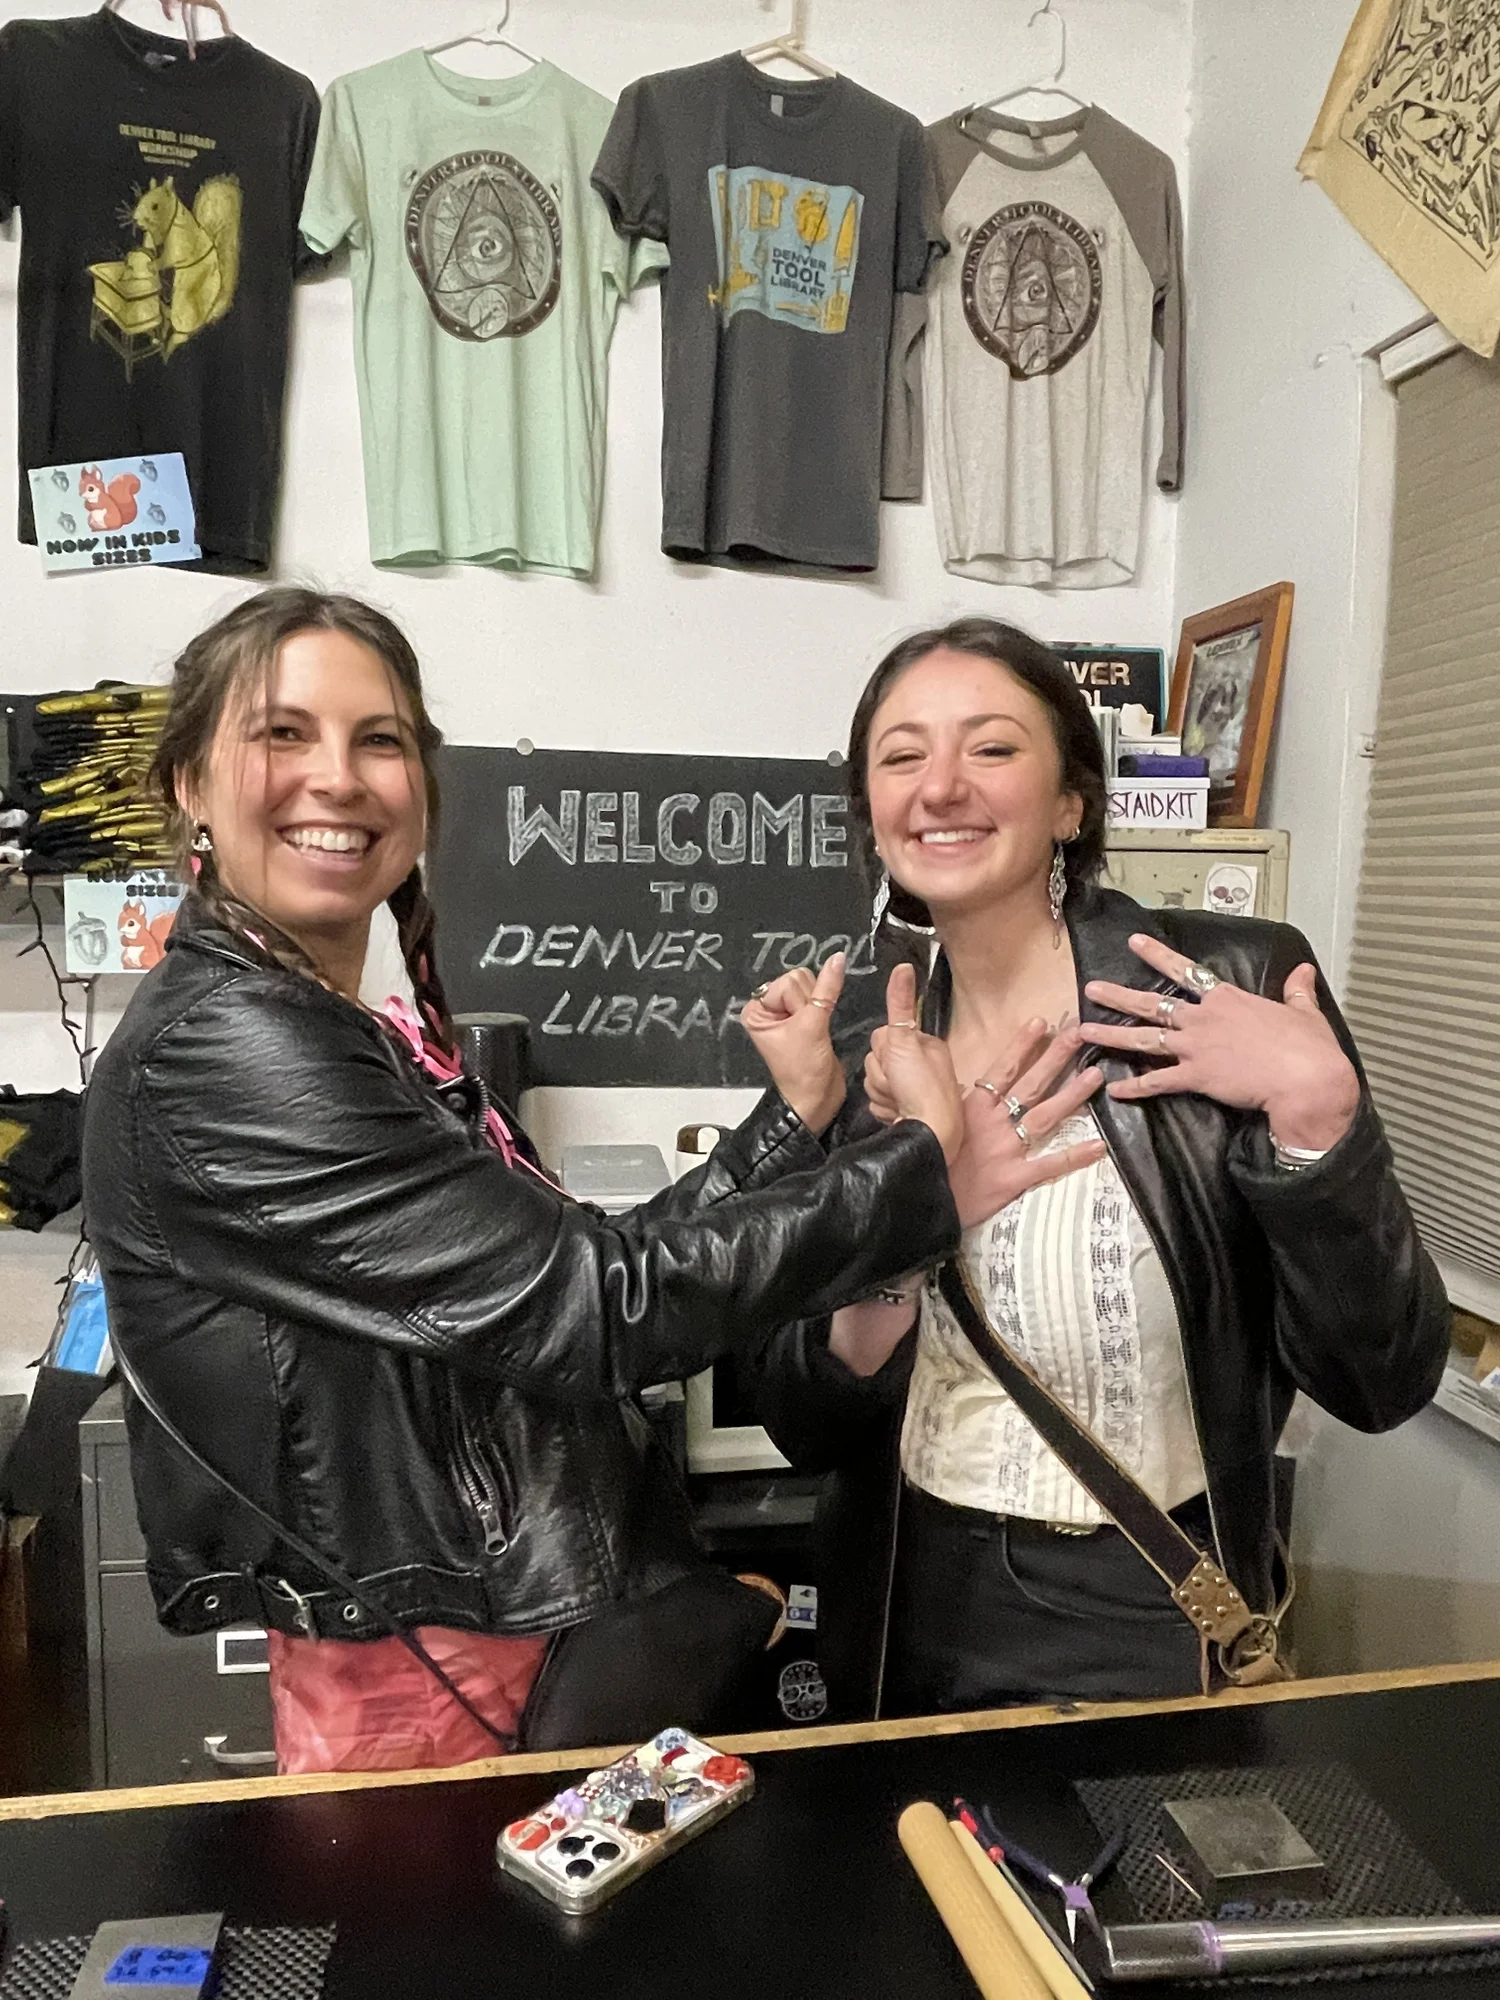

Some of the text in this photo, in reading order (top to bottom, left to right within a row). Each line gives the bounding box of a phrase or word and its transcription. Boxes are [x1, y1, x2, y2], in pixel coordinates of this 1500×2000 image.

[772, 258, 826, 288] TOOL
[773, 247, 827, 272] DENVER
[771, 275, 827, 300] LIBRARY
[46, 528, 181, 555] NOW IN KIDS
[91, 548, 153, 566] SIZES
[505, 785, 849, 868] WELCOME
[650, 881, 719, 914] TO
[478, 922, 879, 976] DENVER TOOL
